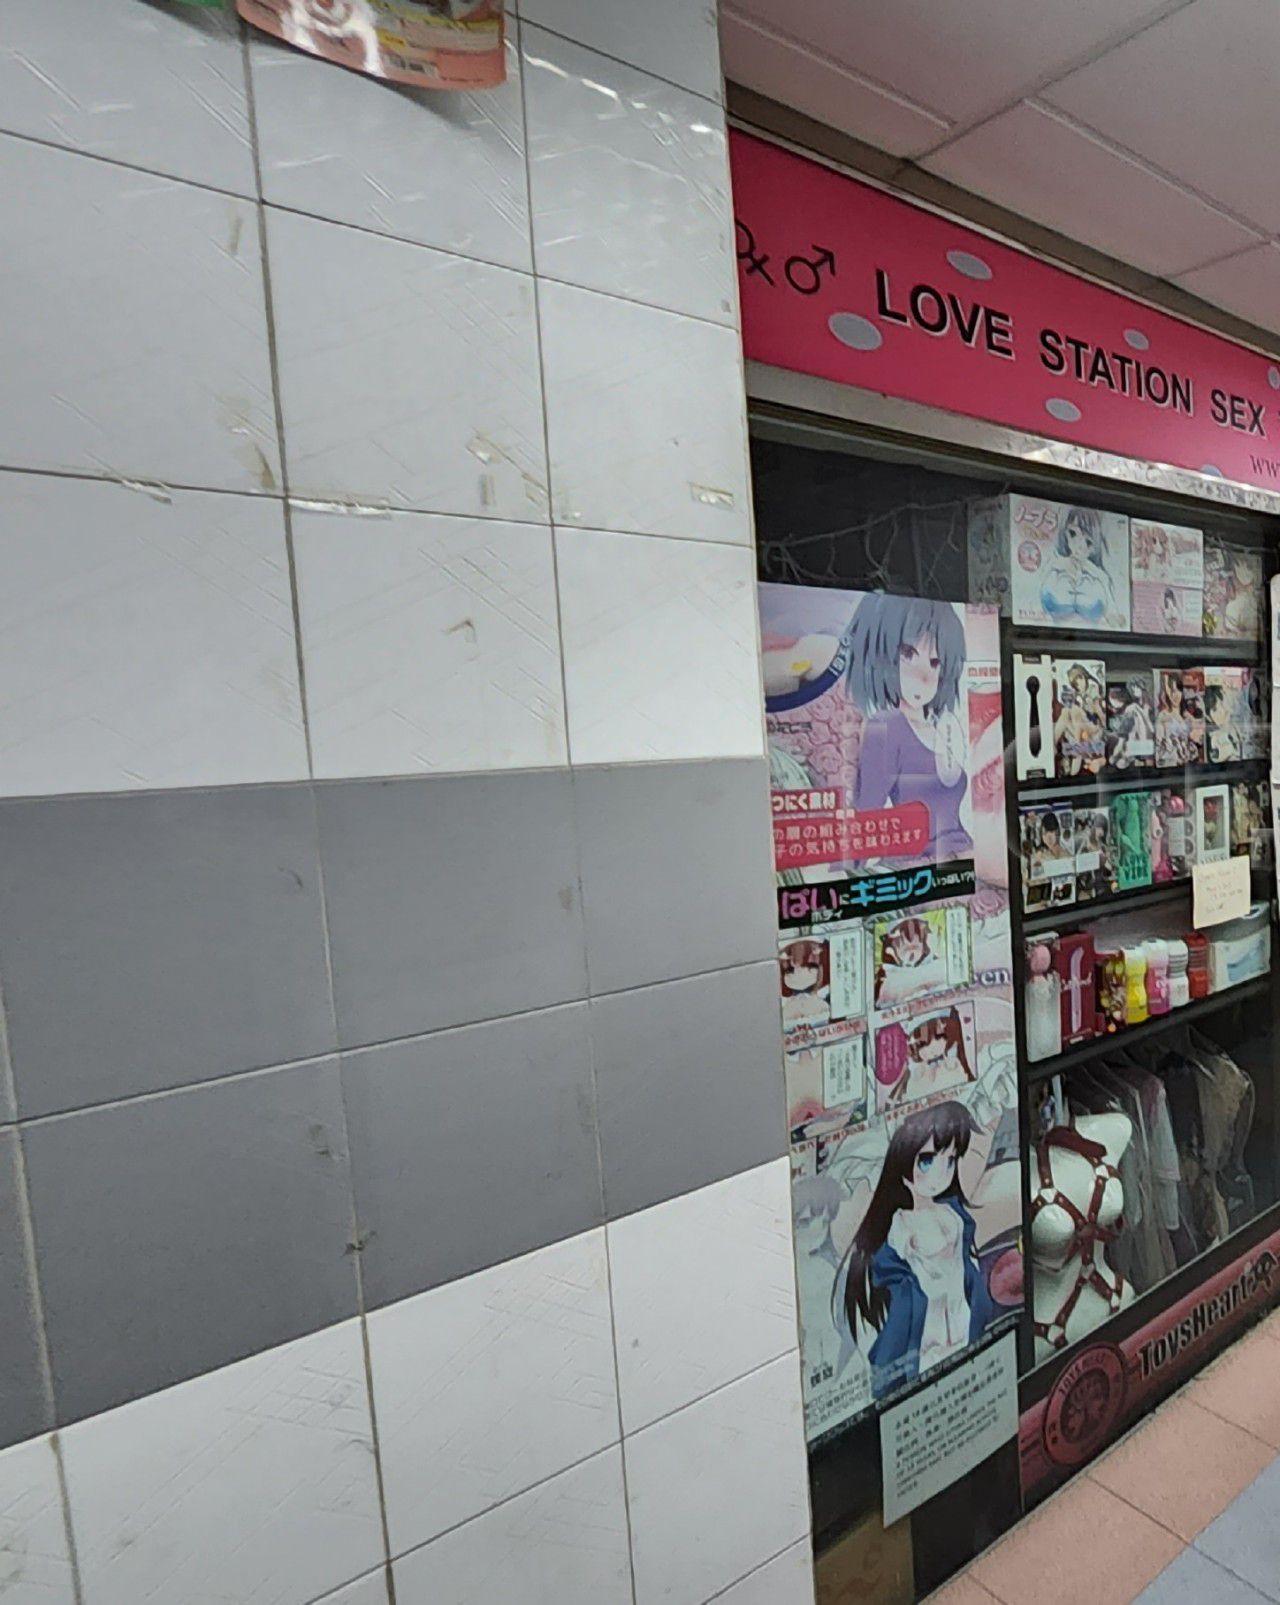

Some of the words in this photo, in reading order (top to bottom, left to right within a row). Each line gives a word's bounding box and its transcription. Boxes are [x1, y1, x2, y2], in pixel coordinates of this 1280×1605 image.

[875, 268, 1013, 358] LOVE
[1039, 328, 1194, 415] STATION
[1210, 388, 1267, 438] SEX
